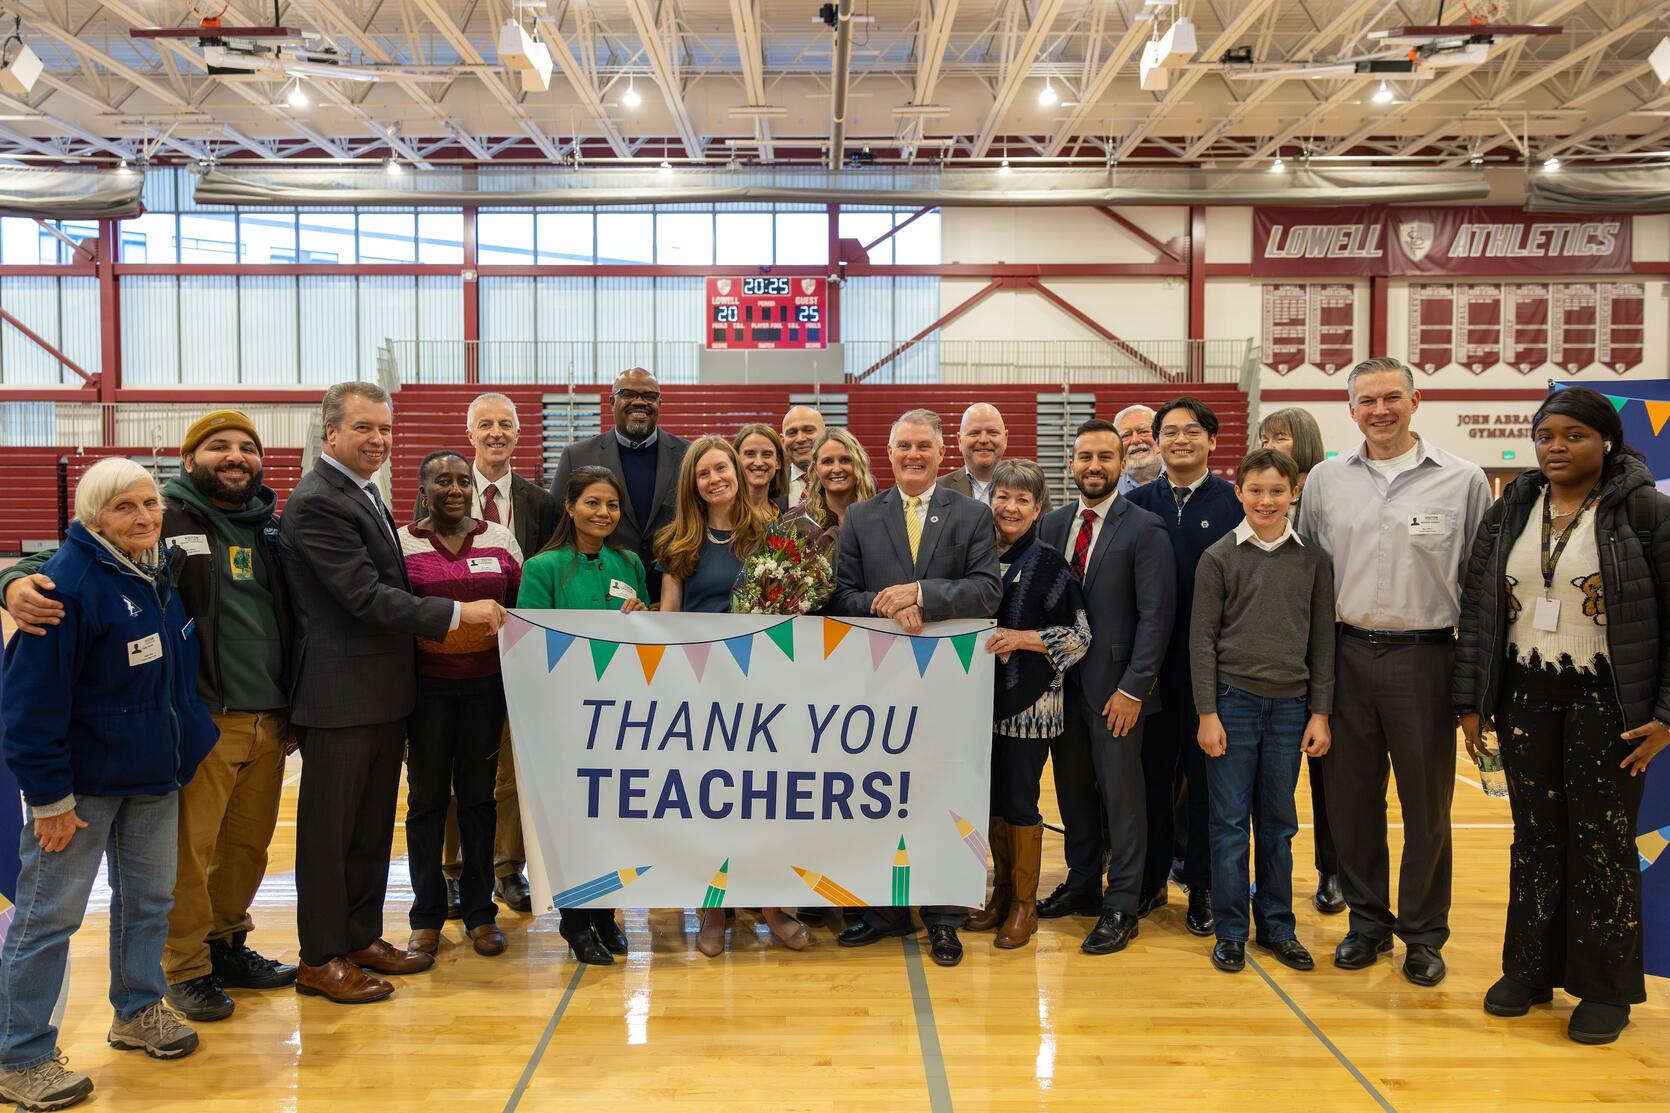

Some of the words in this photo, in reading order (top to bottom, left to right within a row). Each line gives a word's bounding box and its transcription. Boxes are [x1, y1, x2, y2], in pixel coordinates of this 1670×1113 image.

[1264, 224, 1384, 258] LOWELL
[1448, 222, 1620, 257] ATHLETICS
[744, 278, 789, 294] 20:25
[712, 296, 739, 305] LOWELL
[795, 296, 818, 305] GUEST
[718, 306, 738, 322] 20
[799, 306, 819, 322] 25
[1457, 414, 1490, 426] JOHN
[1494, 414, 1533, 425] ABRA
[582, 700, 786, 752] THANK
[808, 704, 918, 754] YOU
[577, 768, 911, 820] TEACHERS!
